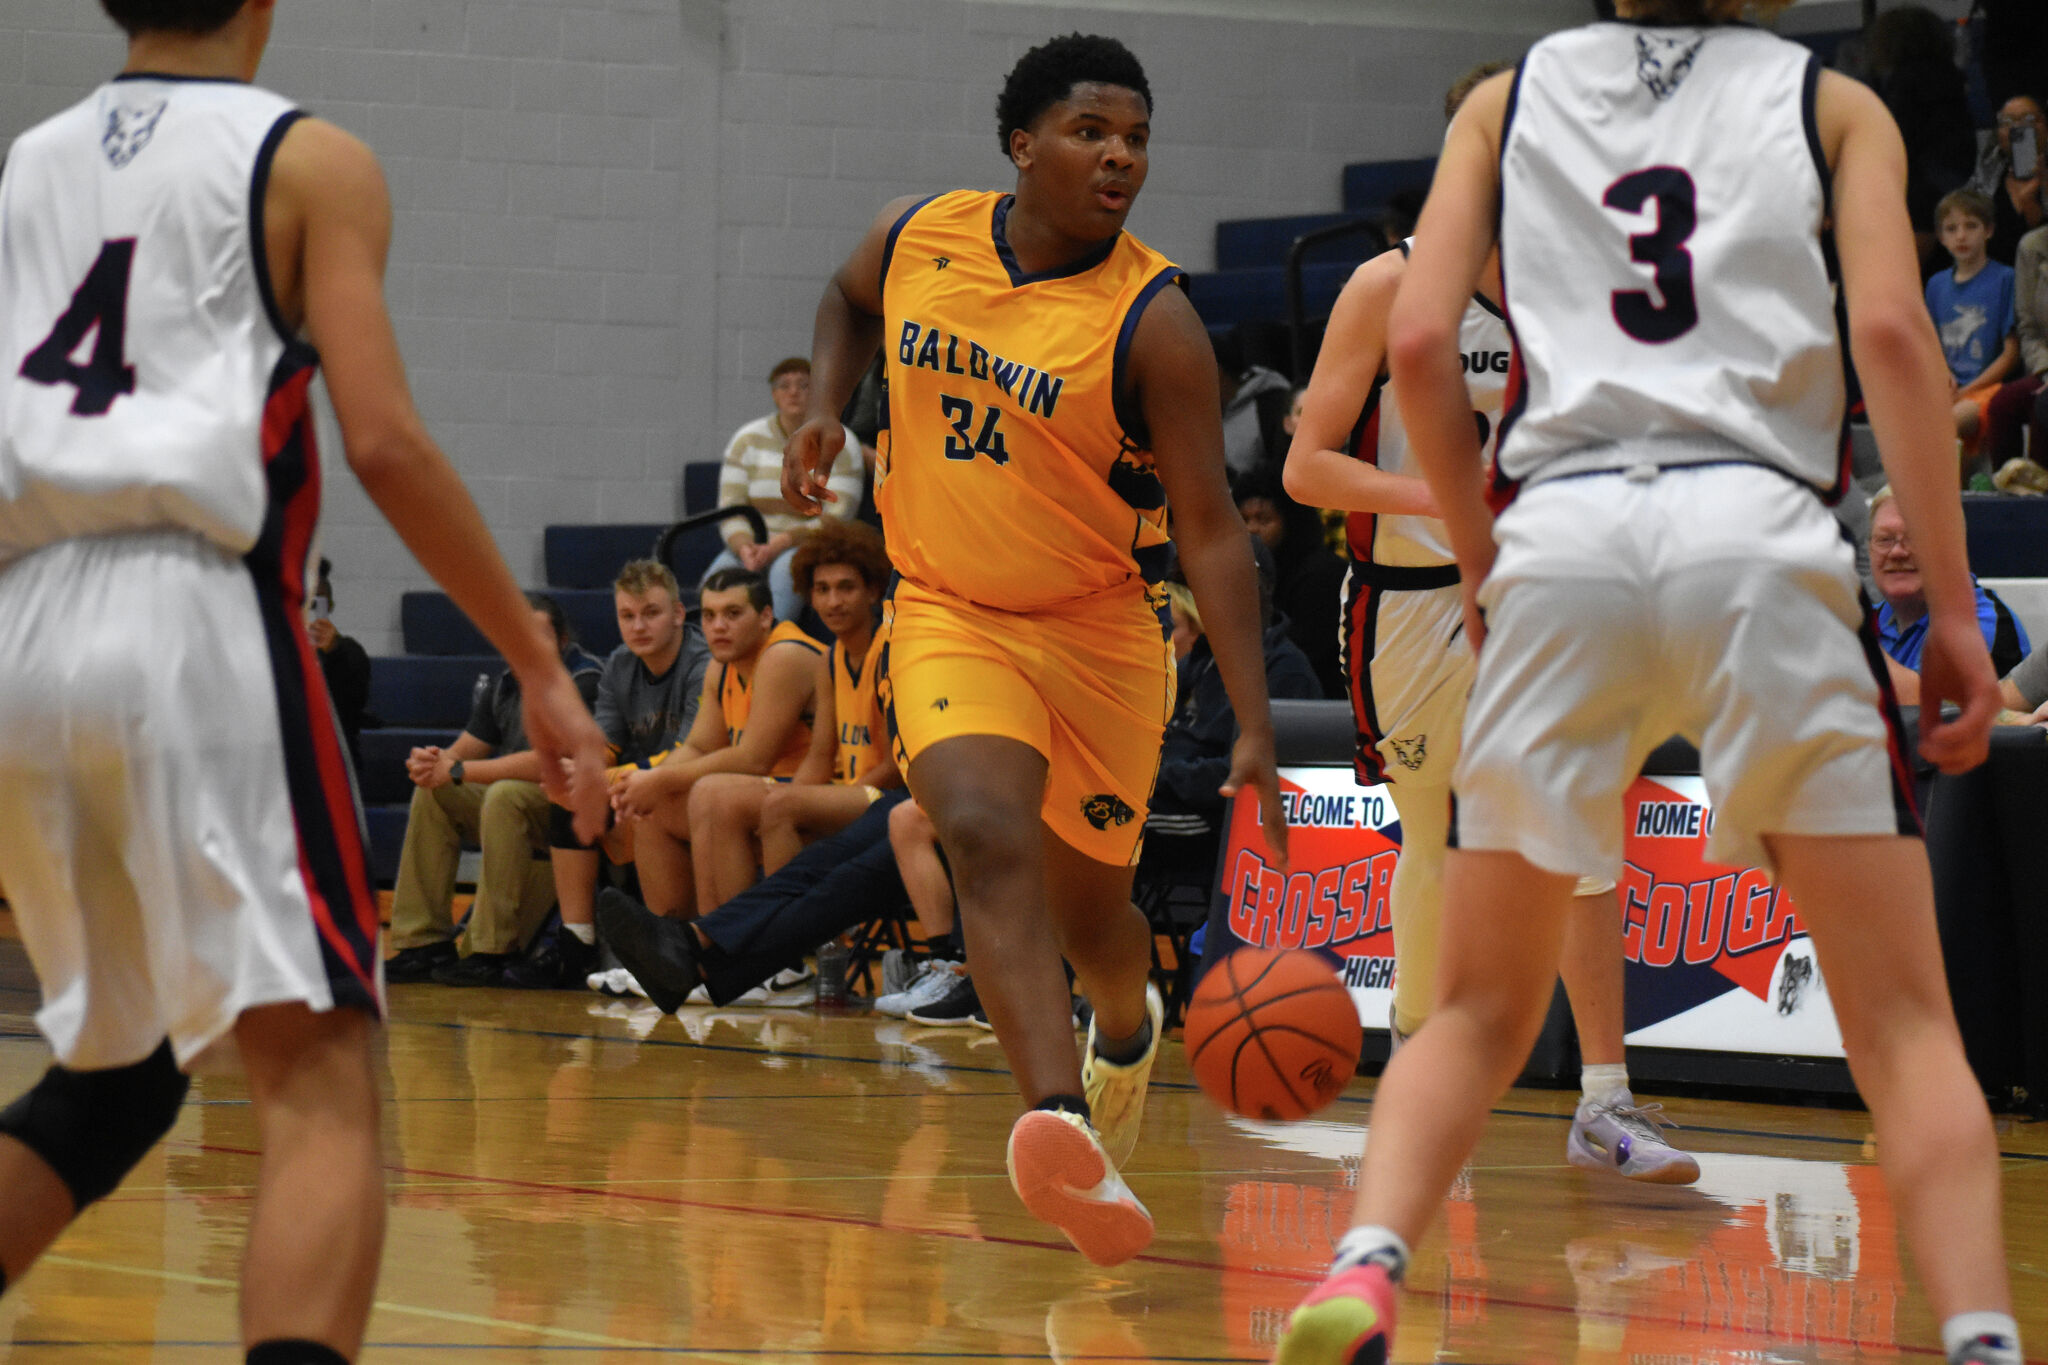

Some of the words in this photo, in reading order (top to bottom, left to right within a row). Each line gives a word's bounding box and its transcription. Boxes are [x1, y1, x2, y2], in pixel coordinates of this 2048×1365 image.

[1602, 164, 1699, 345] 3
[18, 235, 138, 417] 4
[898, 318, 1065, 419] BALDWIN
[938, 392, 1010, 467] 34
[1258, 791, 1356, 827] ELCOME
[1361, 796, 1384, 827] TO
[1635, 802, 1702, 837] HOME
[1344, 956, 1396, 989] HIGH
